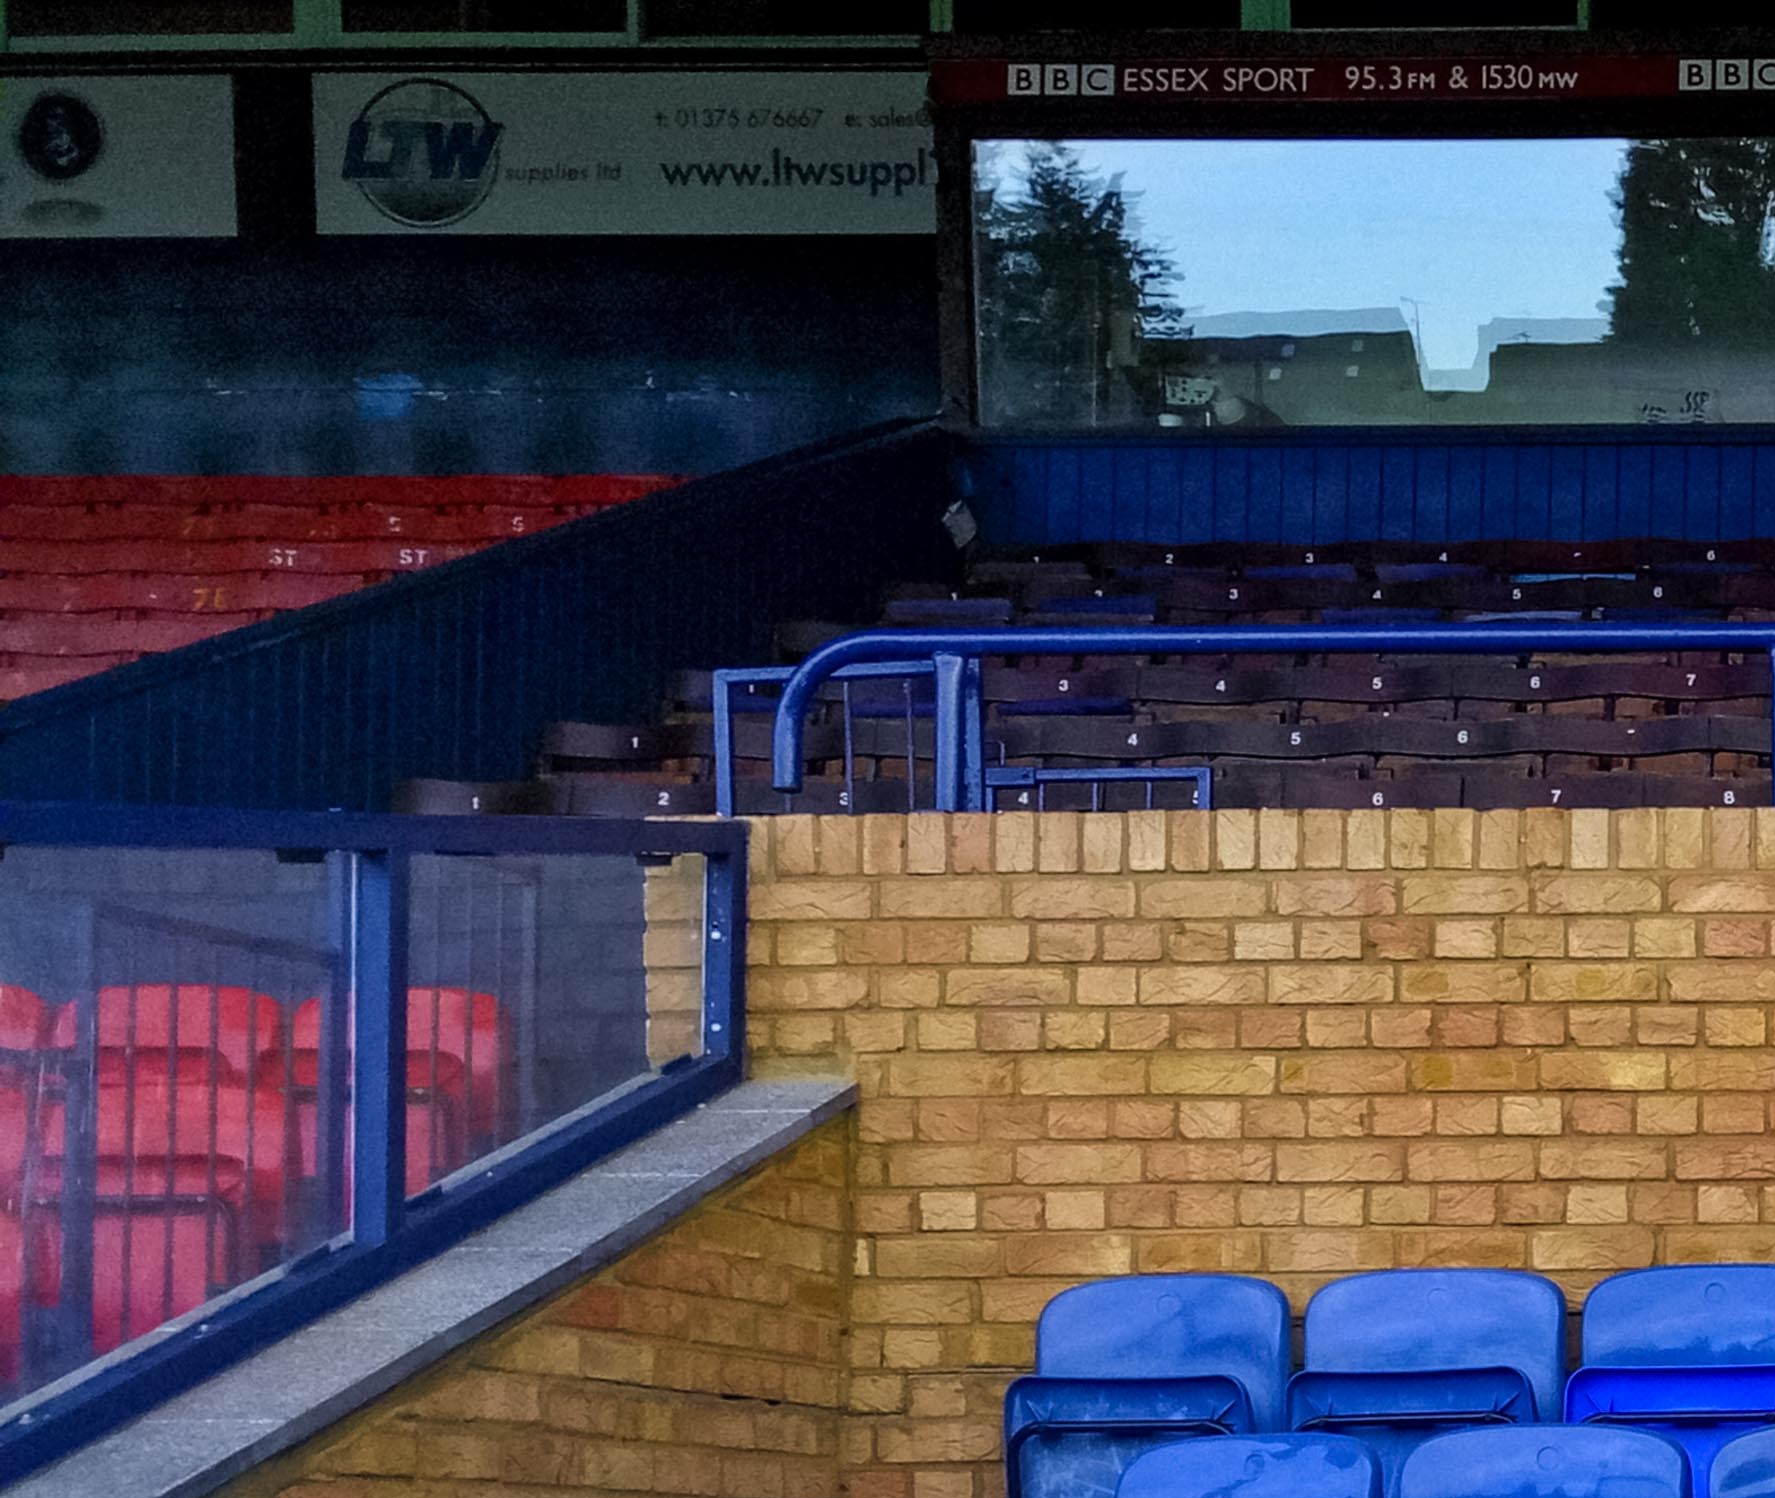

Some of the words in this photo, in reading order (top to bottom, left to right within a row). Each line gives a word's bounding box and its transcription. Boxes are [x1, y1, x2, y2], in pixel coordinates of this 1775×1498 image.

[1008, 64, 1114, 95] BBC
[1123, 66, 1209, 93] ESSEX
[1223, 66, 1315, 93] SPORT
[1449, 64, 1469, 91] &
[342, 120, 504, 179] LTW
[504, 162, 589, 186] supplies
[659, 147, 937, 198] www.ltwsuppl
